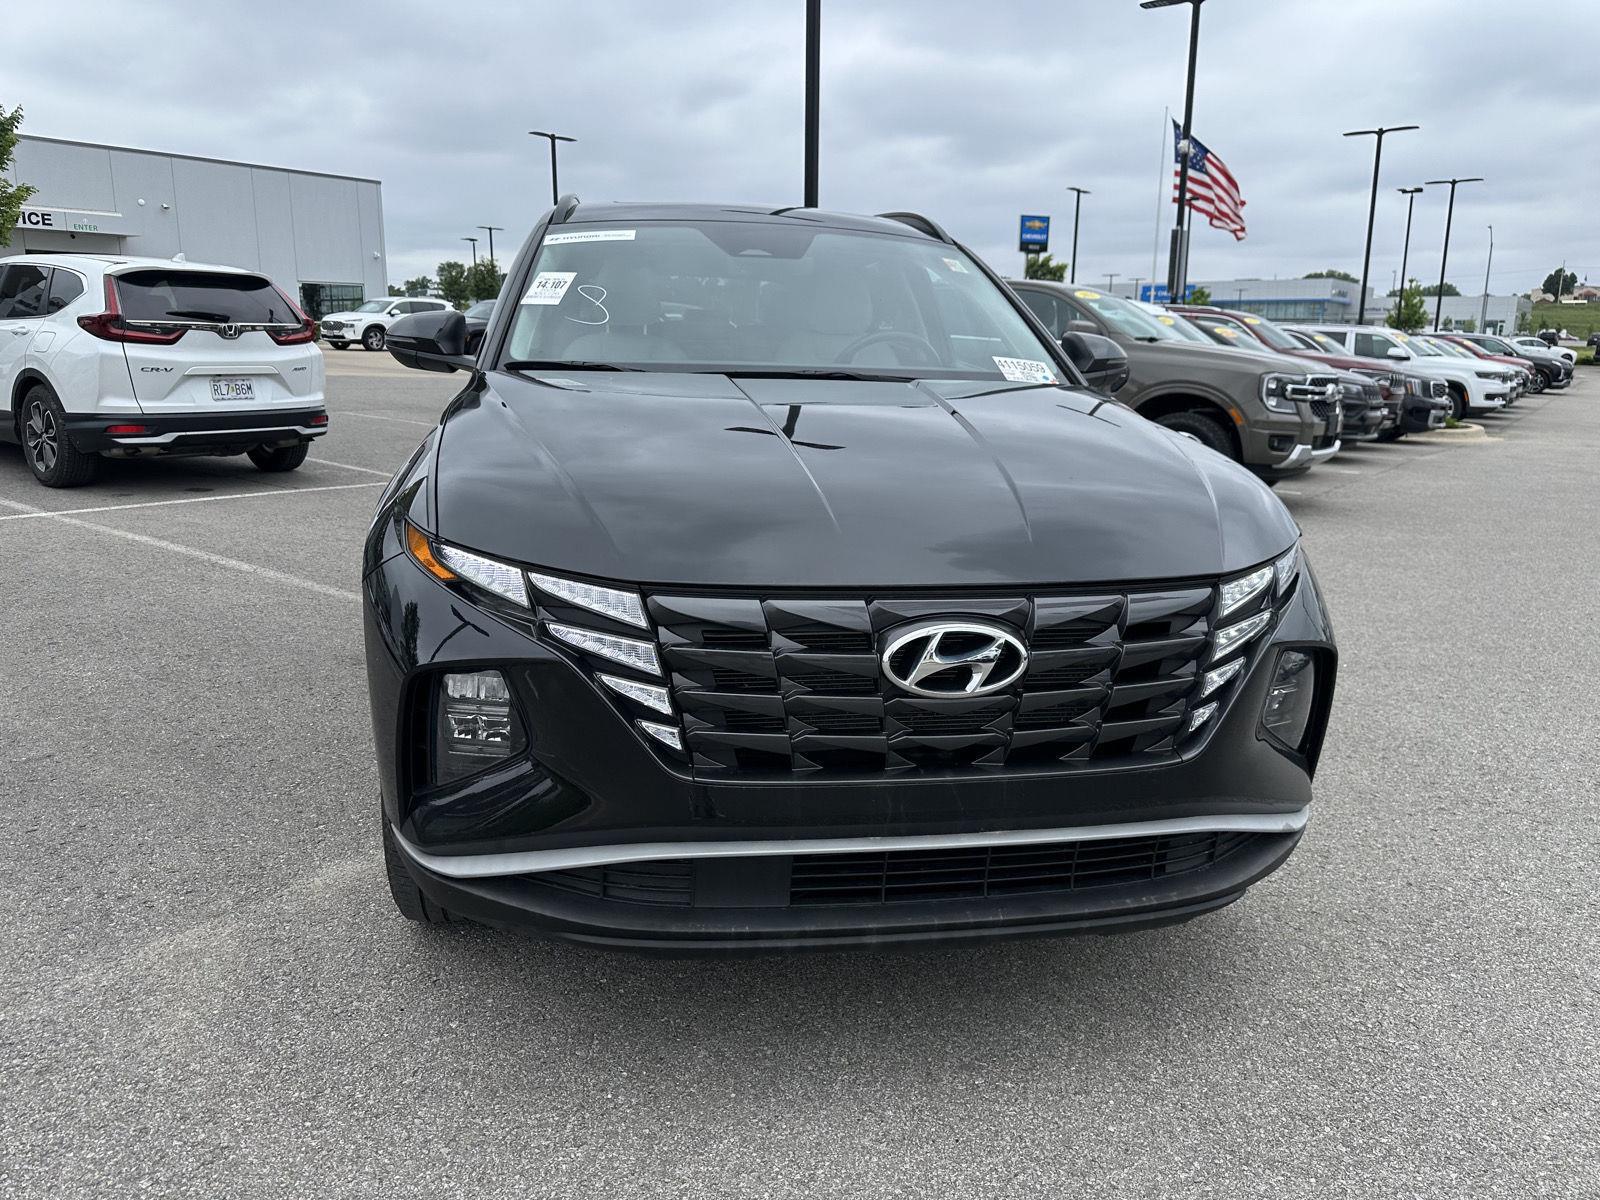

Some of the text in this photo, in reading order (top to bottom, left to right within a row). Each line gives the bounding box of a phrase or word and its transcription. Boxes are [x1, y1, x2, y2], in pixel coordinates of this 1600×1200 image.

[73, 223, 98, 232] ENTER
[213, 383, 253, 396] RL7 B6M
